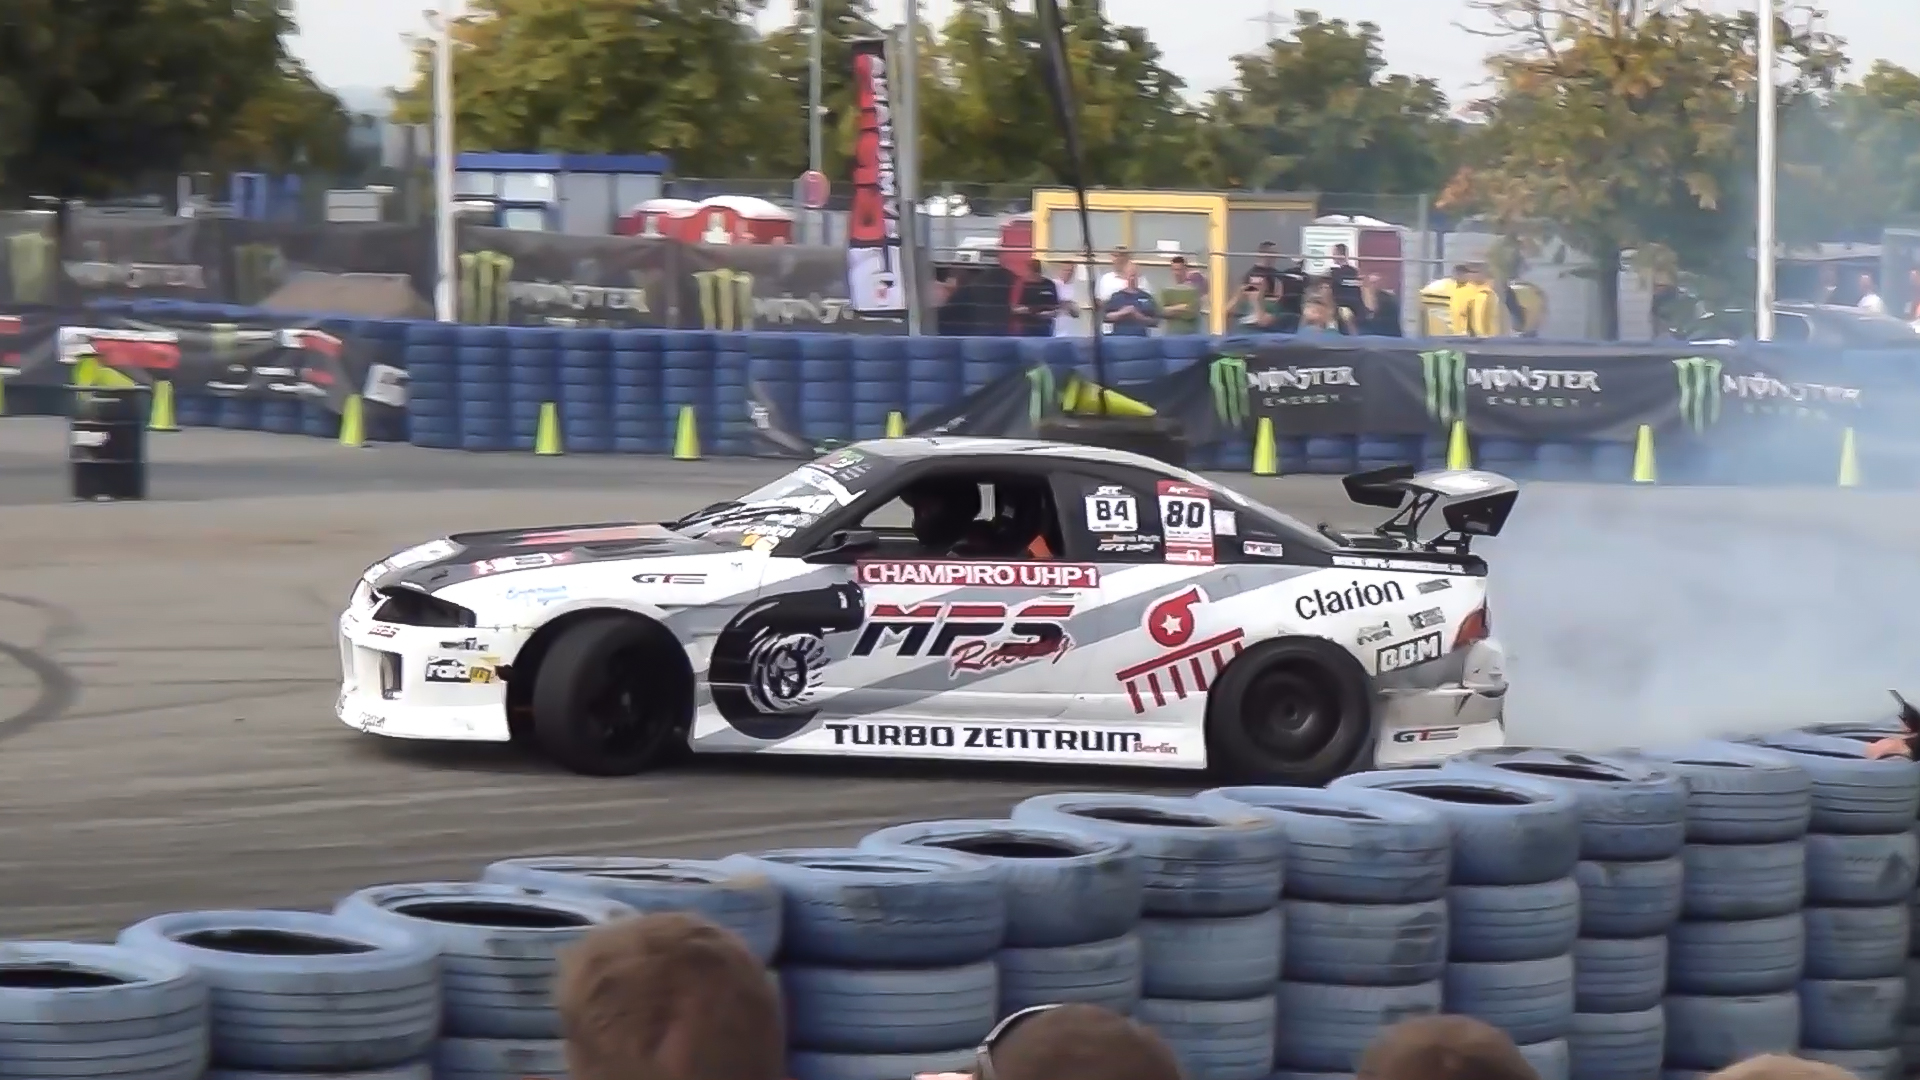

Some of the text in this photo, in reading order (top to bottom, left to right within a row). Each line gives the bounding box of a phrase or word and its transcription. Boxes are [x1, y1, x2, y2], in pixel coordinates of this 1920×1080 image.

[1467, 365, 1602, 393] MONSTER
[1096, 499, 1130, 521] 84
[1166, 500, 1206, 529] 80
[862, 563, 1099, 587] CHAMPIRO UHP1
[850, 603, 1076, 658] MPS
[825, 723, 1143, 753] TURBO ZENTRUM
